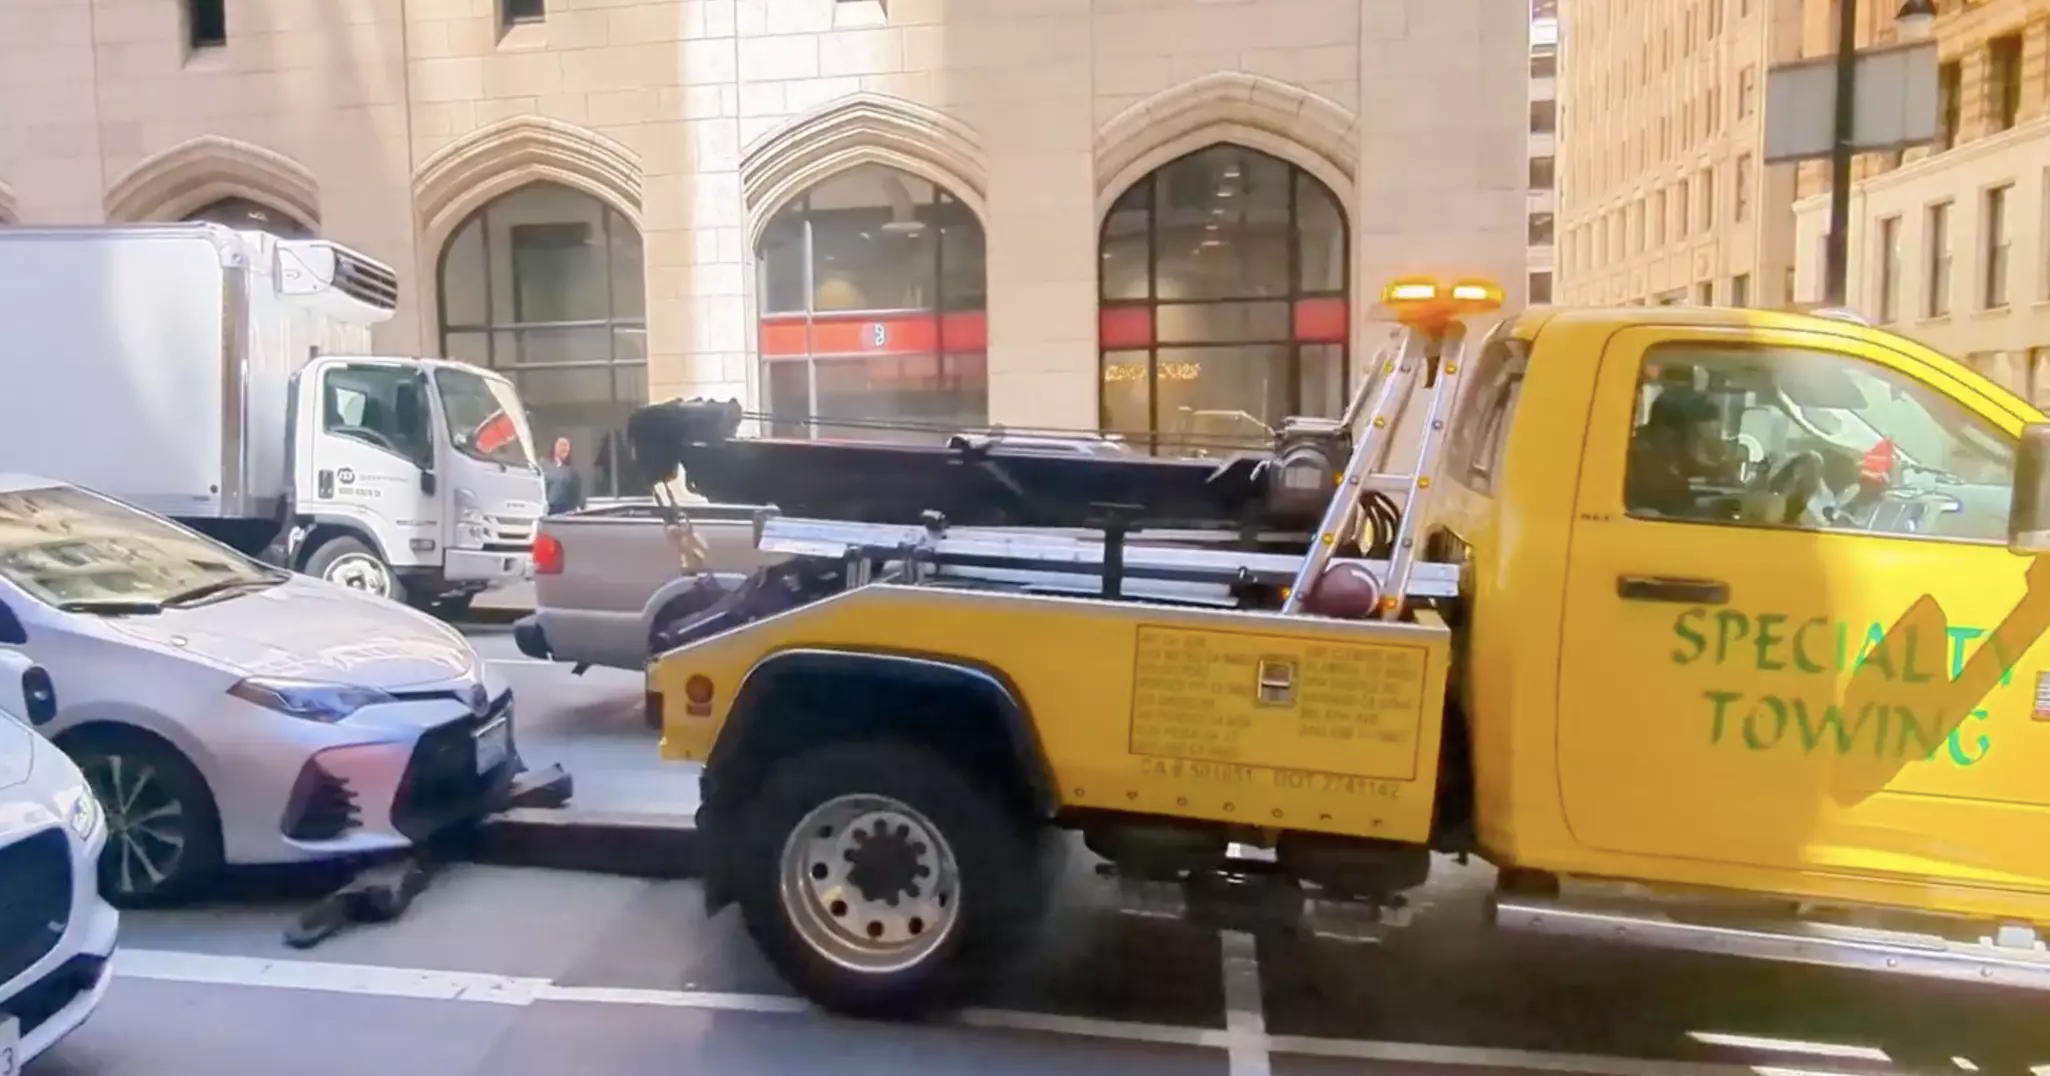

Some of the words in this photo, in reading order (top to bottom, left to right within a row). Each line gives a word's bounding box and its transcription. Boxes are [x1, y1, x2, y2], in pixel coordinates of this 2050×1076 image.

[1670, 606, 2016, 687] SPECIALTY
[1141, 757, 1167, 775] CA
[1702, 690, 1991, 766] TOWING
